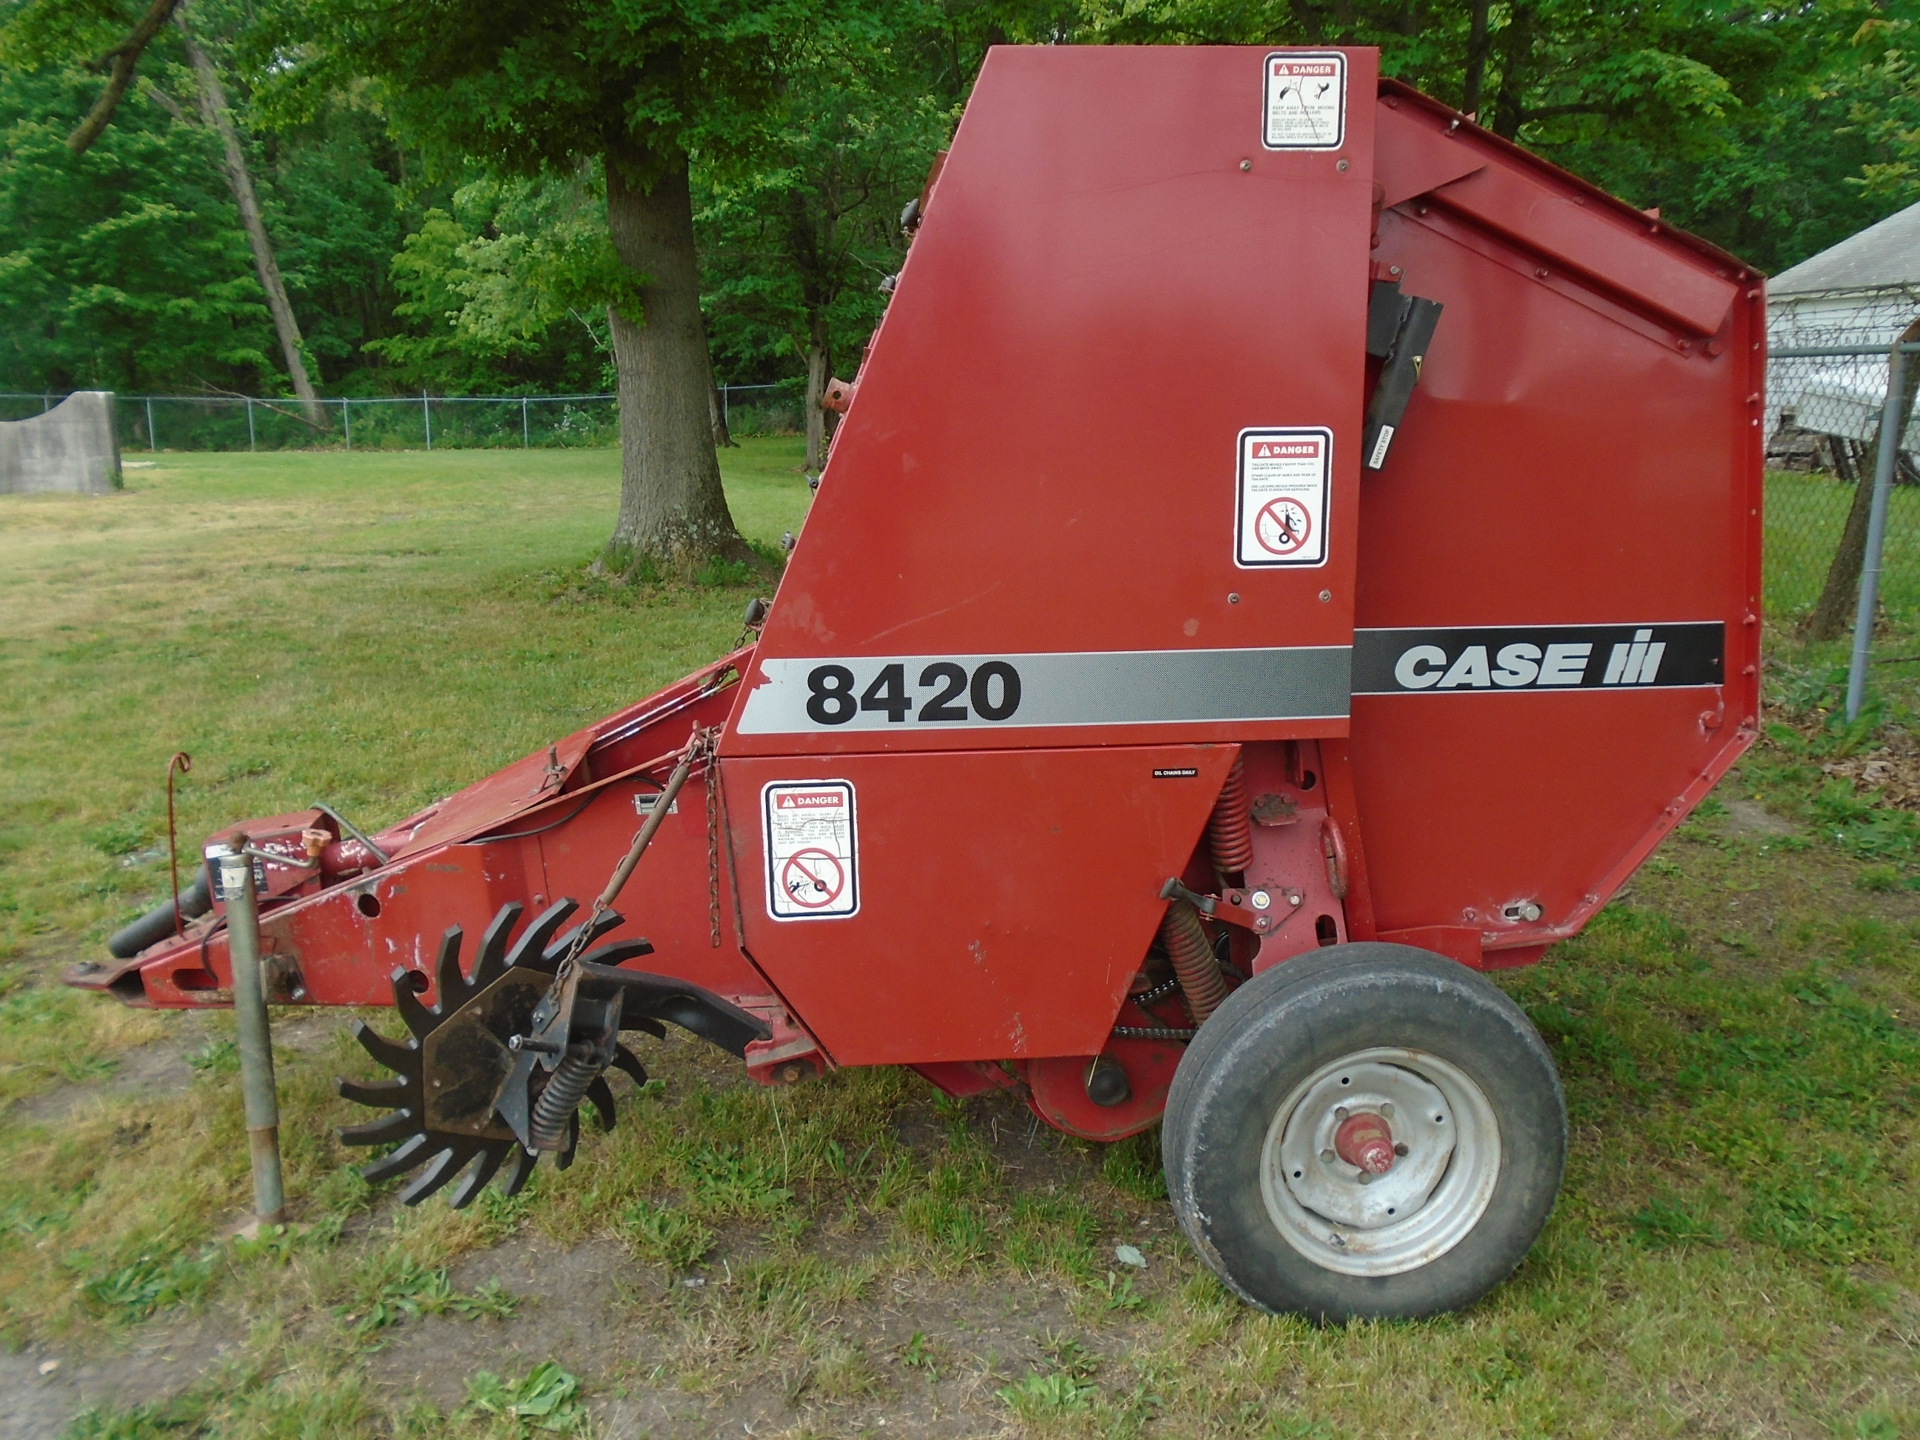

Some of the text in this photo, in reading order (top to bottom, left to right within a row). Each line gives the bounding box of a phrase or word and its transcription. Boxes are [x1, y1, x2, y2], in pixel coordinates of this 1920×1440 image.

[1292, 65, 1331, 74] DANGER
[1273, 445, 1315, 454] DANGER
[1394, 642, 1593, 689] CASE
[806, 660, 1022, 725] 8420
[797, 796, 840, 806] DANGER
